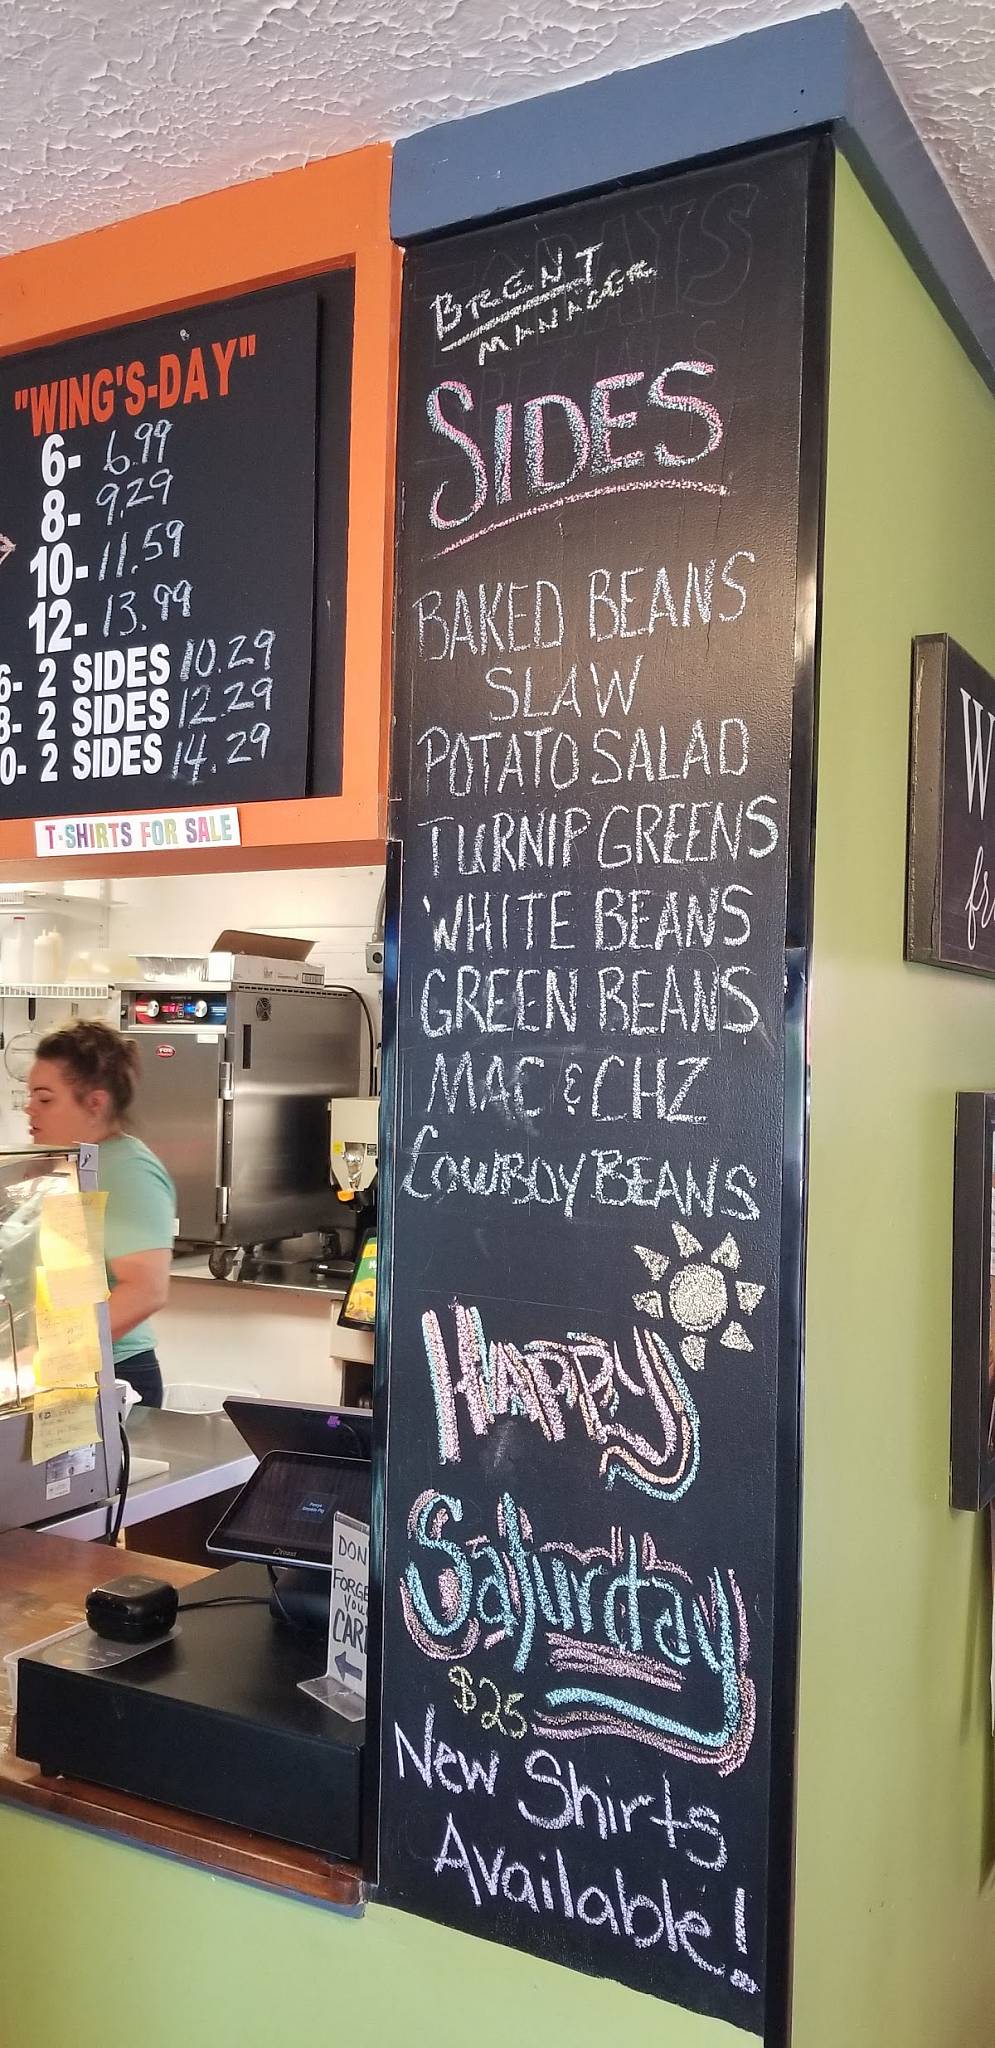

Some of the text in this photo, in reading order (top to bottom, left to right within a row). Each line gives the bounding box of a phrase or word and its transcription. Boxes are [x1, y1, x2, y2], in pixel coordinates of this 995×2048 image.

[429, 242, 604, 342] BRENT
[477, 259, 659, 367] MANAGER
[14, 334, 257, 438] "WING'S-DAY"
[41, 419, 173, 487] 6- 6.99
[425, 360, 724, 532] SIDES
[41, 468, 174, 543] 8- 9.29
[29, 519, 185, 599] 10- 11.59
[28, 579, 194, 655] 12- 13.99
[411, 550, 756, 661] BAKED BEANS
[38, 657, 57, 698] 2
[72, 643, 171, 695] SIDES
[180, 628, 276, 682] 10.29
[485, 654, 645, 722] SLAW
[37, 700, 56, 741] 2
[72, 688, 170, 738] SIDES
[178, 677, 274, 730] 12.29
[40, 742, 58, 783] 2
[72, 732, 164, 782] SIDES
[171, 722, 272, 787] 14.29
[416, 717, 750, 798] POTATO SALAD
[45, 813, 233, 851] T-SHIRTS FOR SALE
[416, 794, 780, 878] TURNIP GREENS
[423, 884, 754, 954] WHITE BEANS
[419, 963, 761, 1039] GREEN BEANS
[426, 1050, 545, 1118] MAC
[590, 1053, 712, 1125] CHZ
[401, 1124, 761, 1221] COWBOY BEANS
[399, 1488, 758, 1725] Saturday
[447, 1666, 529, 1740] $25
[394, 1703, 728, 1872] New Shirts
[433, 1811, 761, 1995] Available!
